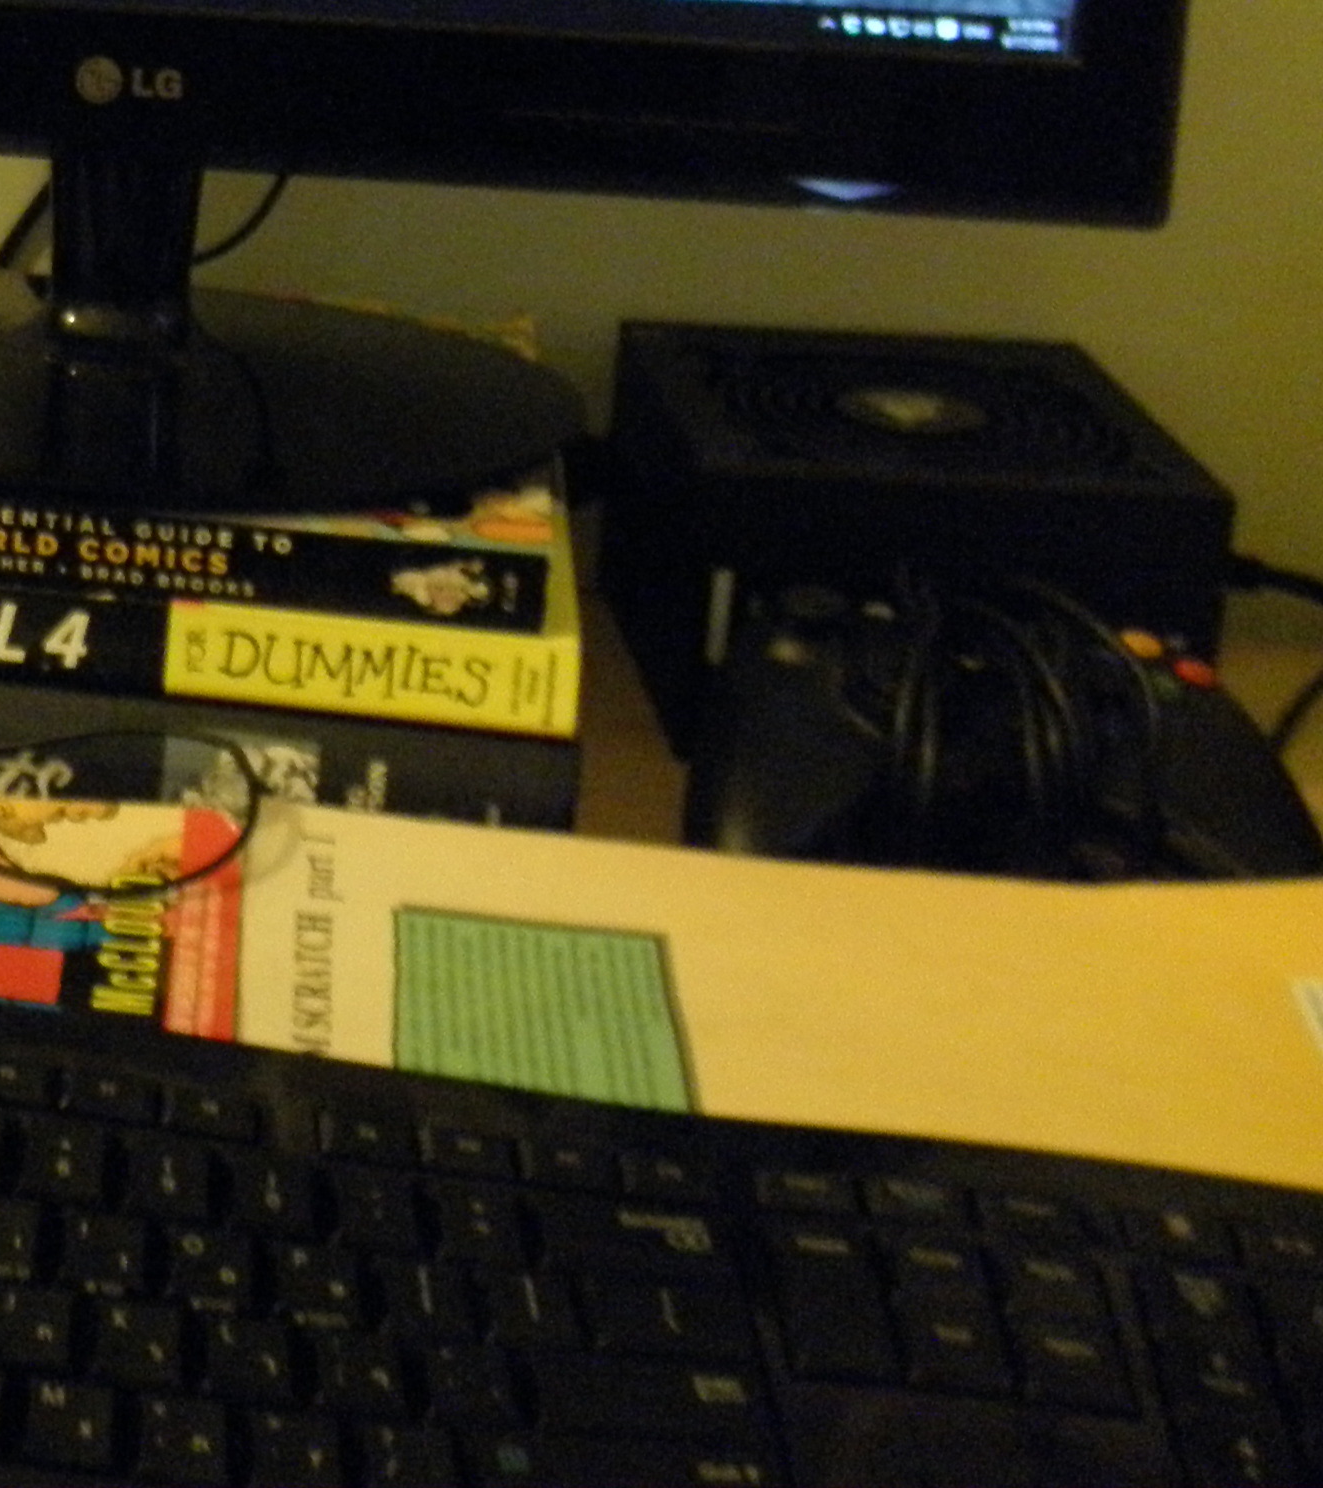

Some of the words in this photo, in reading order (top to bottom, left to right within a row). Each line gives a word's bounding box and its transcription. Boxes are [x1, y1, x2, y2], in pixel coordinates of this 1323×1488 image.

[132, 67, 184, 100] LG
[134, 521, 234, 550] GUIDE
[253, 533, 293, 556] TO
[78, 539, 230, 577] COMICS
[80, 565, 145, 587] BRAD
[42, 609, 91, 670] 4
[218, 630, 493, 708] DUMMIES
